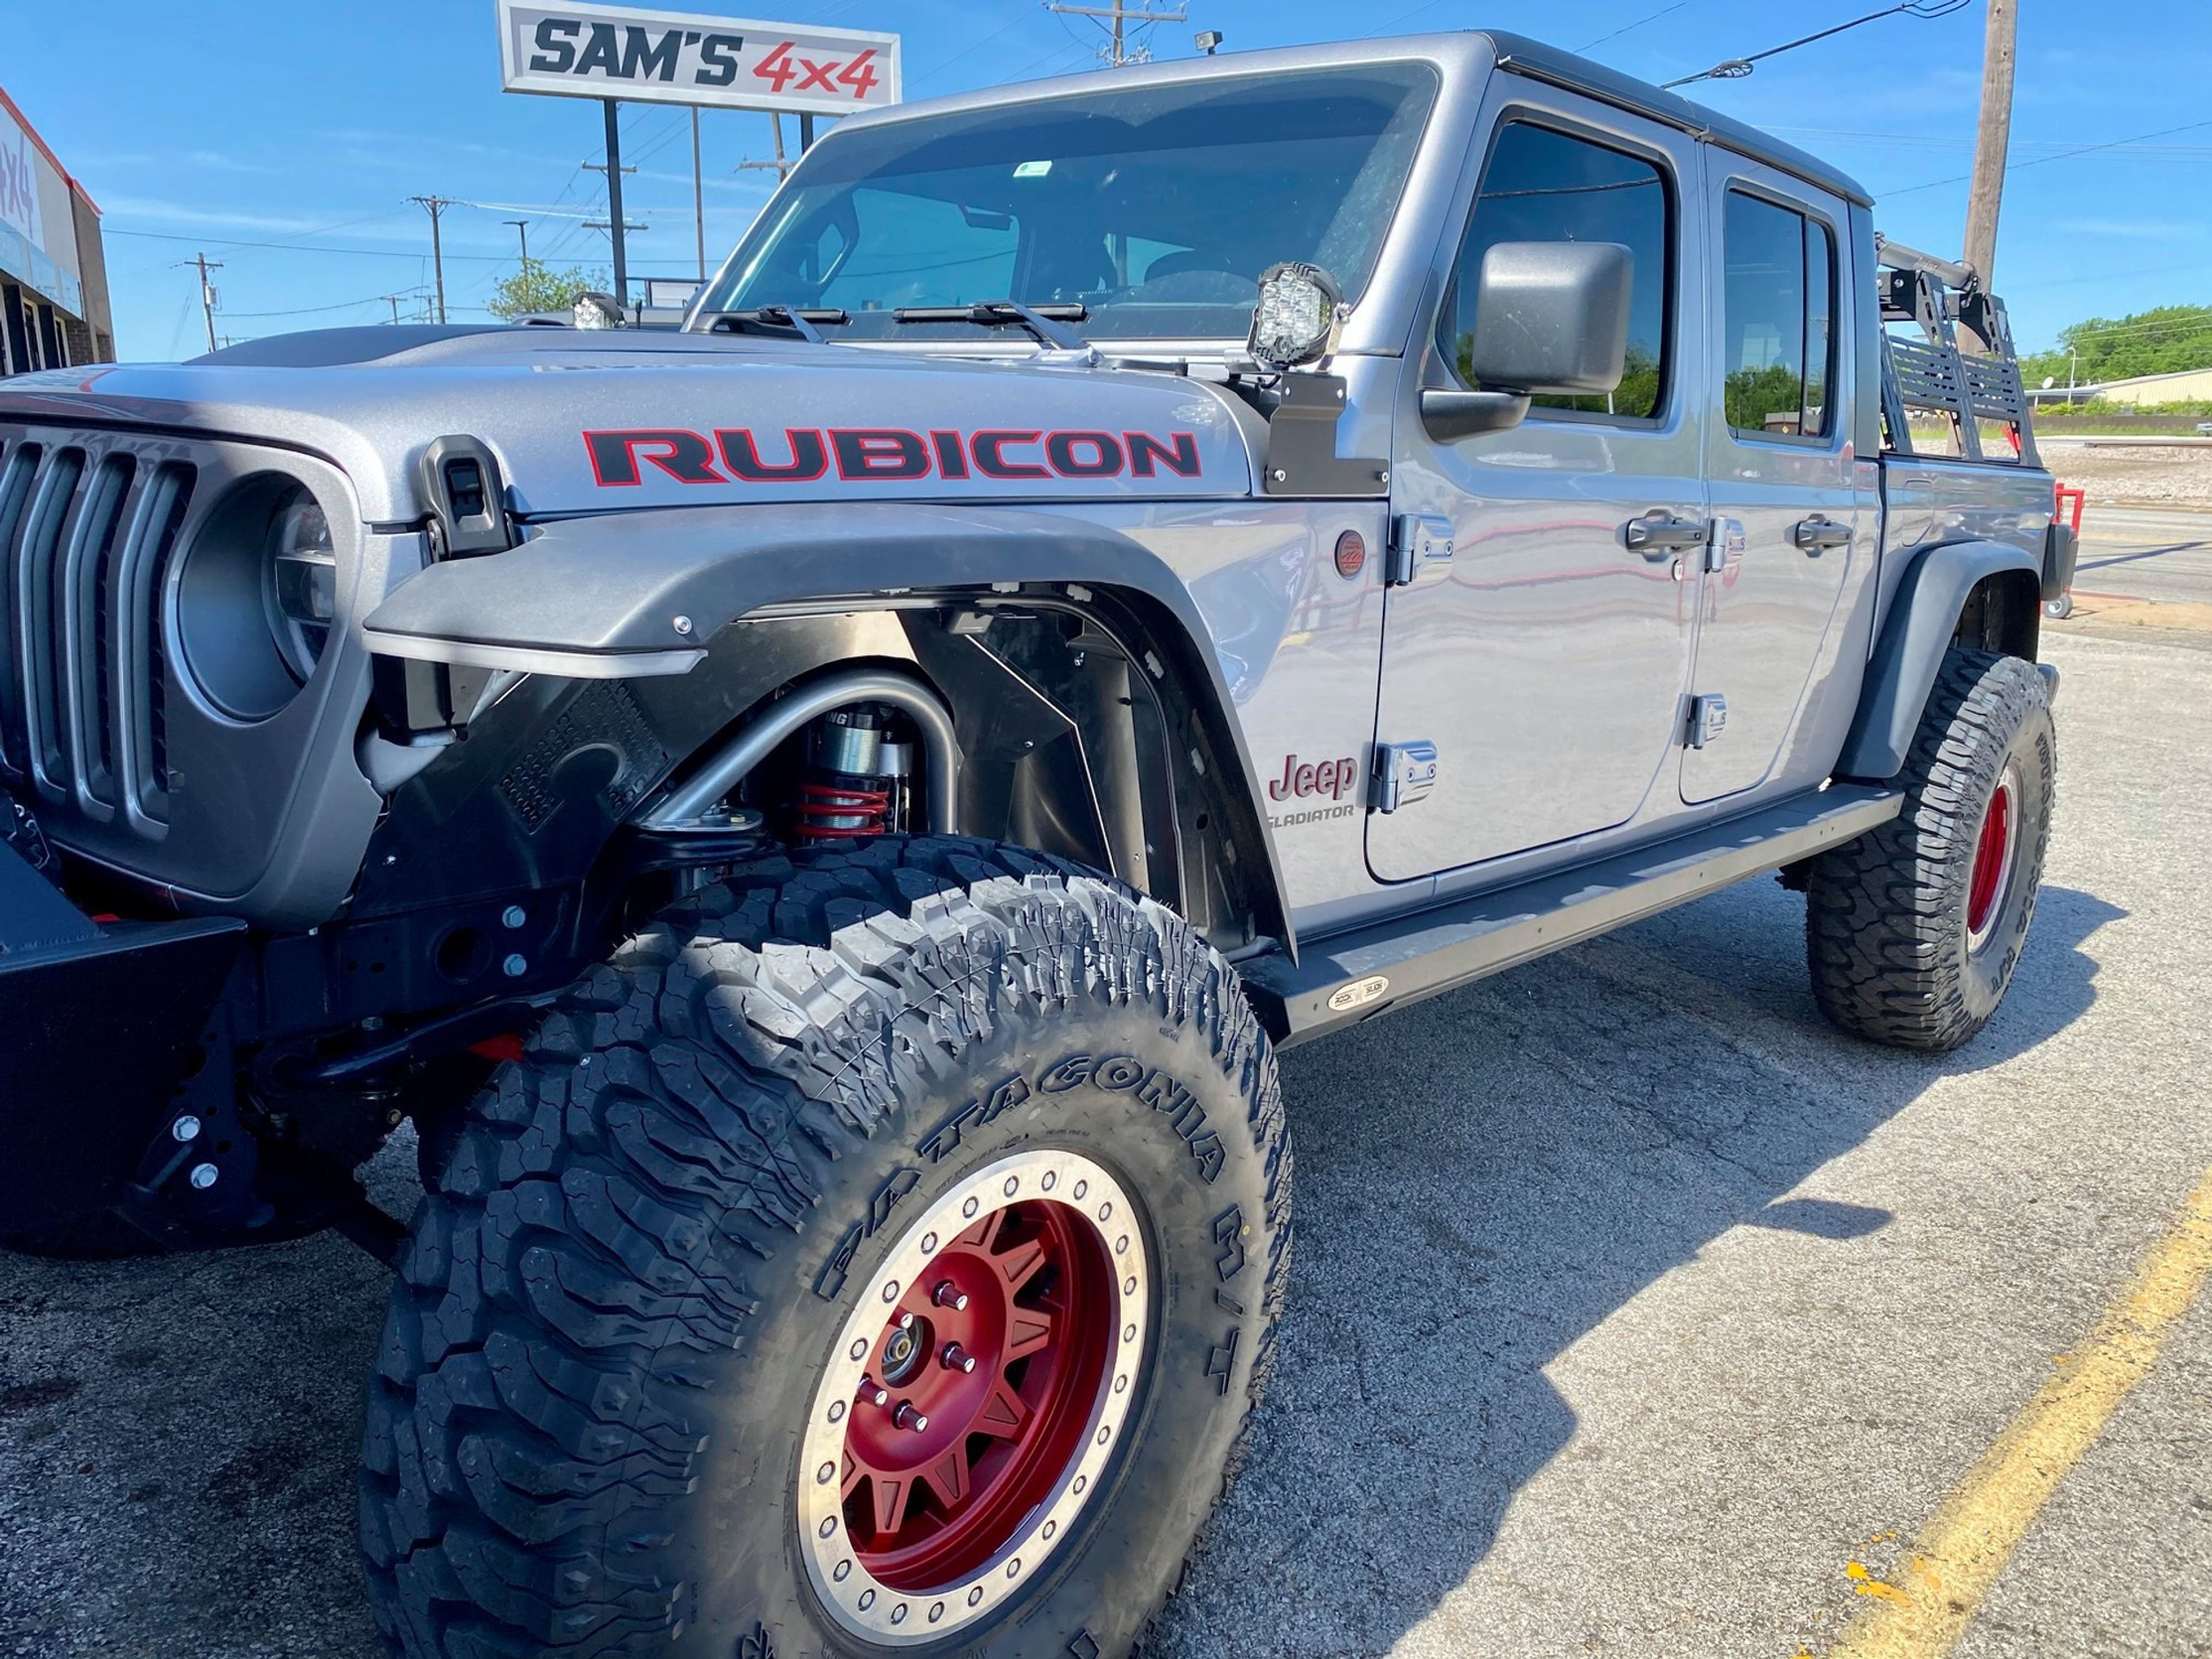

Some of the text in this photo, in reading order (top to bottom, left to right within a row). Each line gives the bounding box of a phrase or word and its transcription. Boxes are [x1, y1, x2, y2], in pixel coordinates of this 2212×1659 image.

[529, 18, 879, 99] SAM'S 4x4
[582, 428, 1202, 488] RUBICON
[1269, 754, 1358, 802] Jeep
[813, 1056, 1227, 1302] PATAGONIA
[1204, 1203, 1248, 1397] M/T
